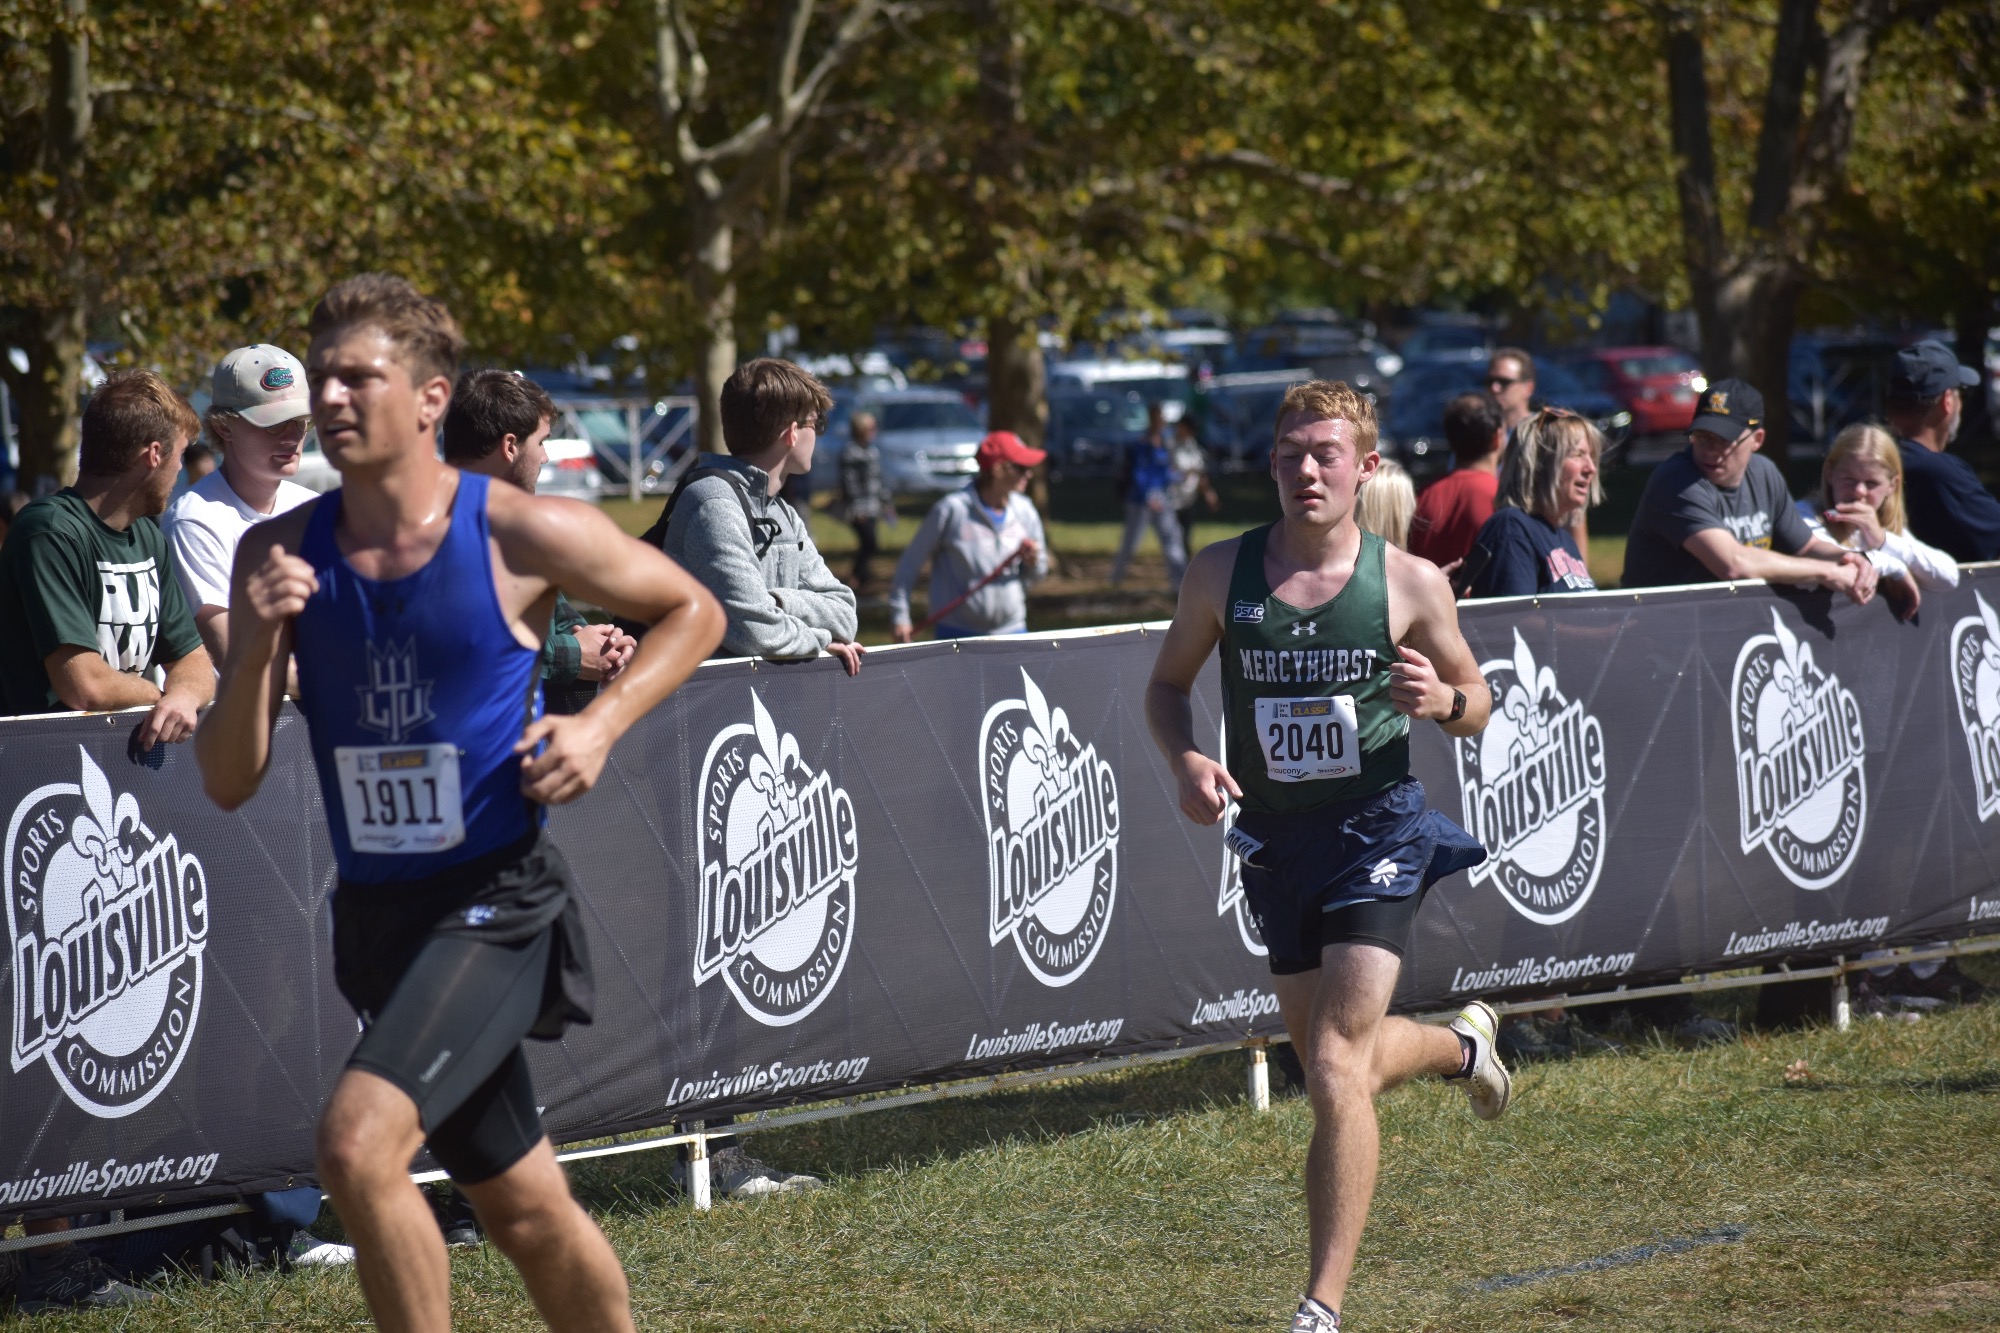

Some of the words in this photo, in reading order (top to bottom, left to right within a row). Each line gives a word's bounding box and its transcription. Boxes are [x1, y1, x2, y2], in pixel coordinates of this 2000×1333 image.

[1234, 606, 1264, 618] PSAC
[1239, 648, 1377, 683] MERCYHURST
[1740, 651, 1773, 736] SPORTS
[1963, 633, 1981, 711] SPORTS
[1268, 721, 1344, 762] 2040
[1292, 706, 1330, 716] CLASSIC
[355, 777, 444, 827] 1911
[709, 746, 746, 845] SPORTS
[990, 720, 1019, 812] SPORTS
[1739, 674, 1866, 855] Louisville
[19, 807, 66, 915] SPORTS
[989, 742, 1121, 947] Louisville
[1504, 813, 1597, 909] COMMISSION
[1778, 781, 1860, 873] COMMISSION
[693, 770, 859, 987] Louisville
[1026, 866, 1111, 967] COMMISSION
[12, 832, 209, 1074] Louisville
[740, 898, 848, 1008] COMMISSION
[1450, 950, 1636, 994] LouisvilleSports.org
[1723, 914, 1890, 957] LouisvilleSports.org
[66, 976, 192, 1097] COMMISSION
[965, 1017, 1125, 1062] LouisvilleSports.org
[665, 1055, 871, 1107] LouisvilleSports.org
[0, 1152, 221, 1204] ouisvilleSports.org
